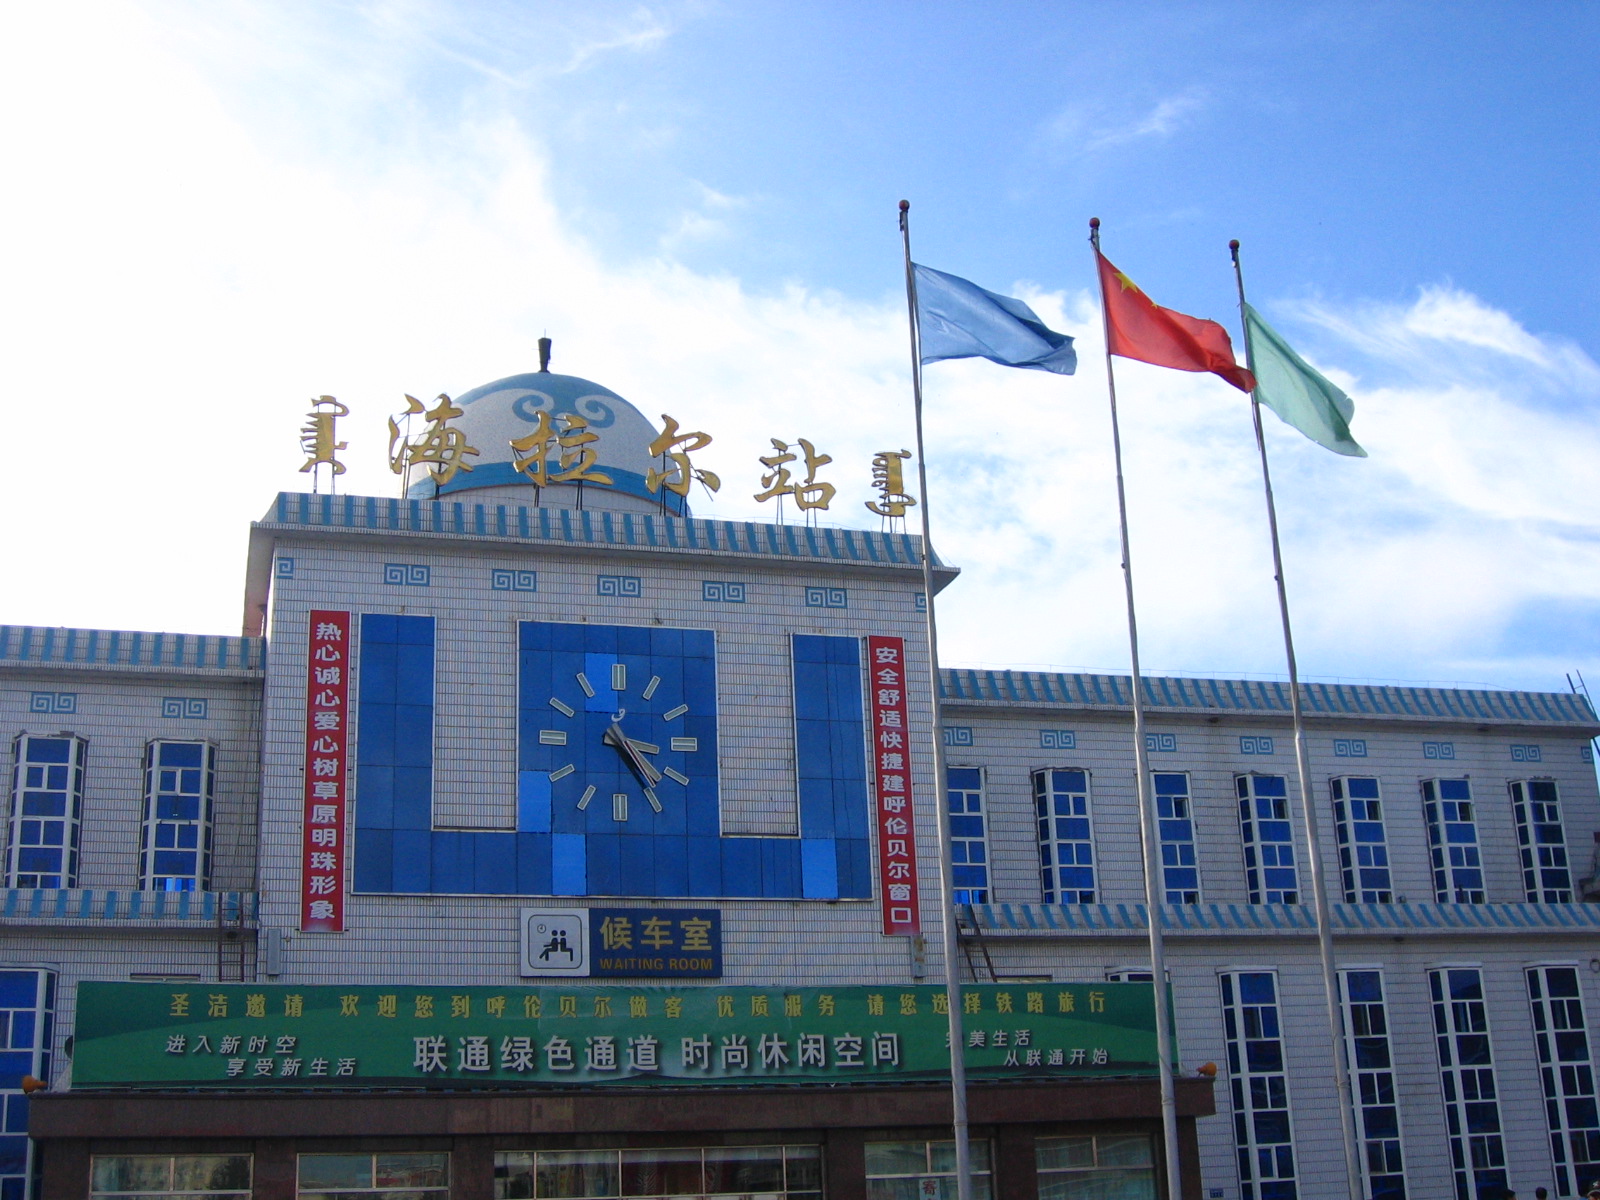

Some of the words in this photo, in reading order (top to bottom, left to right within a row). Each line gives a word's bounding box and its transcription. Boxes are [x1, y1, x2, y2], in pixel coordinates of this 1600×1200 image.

[388, 393, 836, 511] 海拉尔站
[309, 622, 342, 919] 热心诚心爱心树草原明珠形象
[875, 646, 912, 923] 安全舒适快捷建呼伦贝尔窗口
[600, 916, 712, 951] 候车室
[600, 958, 664, 970] WAITING
[669, 958, 712, 970] ROOM
[165, 1034, 297, 1054] 进入新时空
[412, 1034, 660, 1073] 联通绿色通道
[680, 1031, 900, 1070] 时尚休闲空间
[1003, 1047, 1108, 1067] 从联通开始
[225, 1057, 357, 1077] 享受新生活
